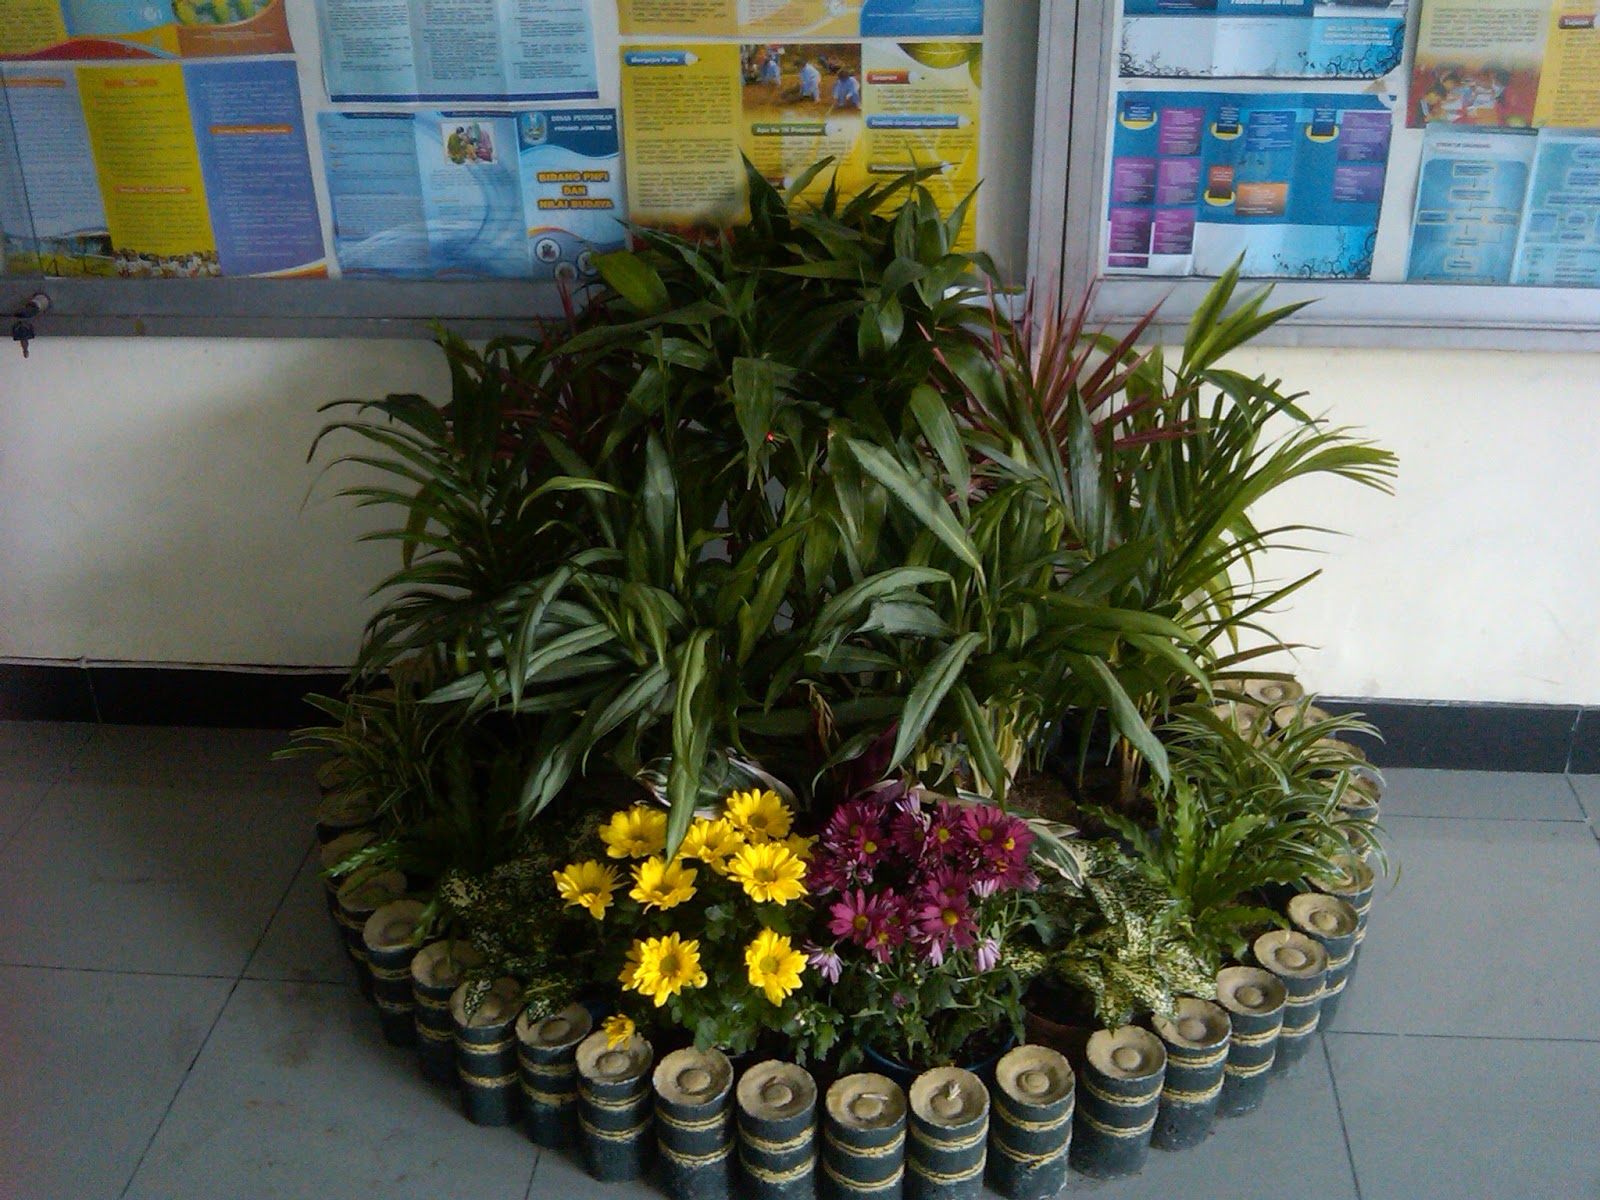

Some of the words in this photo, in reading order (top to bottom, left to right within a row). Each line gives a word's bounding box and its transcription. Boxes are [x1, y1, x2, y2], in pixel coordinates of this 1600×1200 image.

[538, 171, 580, 182] BIDANG
[562, 185, 587, 196] DAN
[569, 198, 614, 210] BUDAYA
